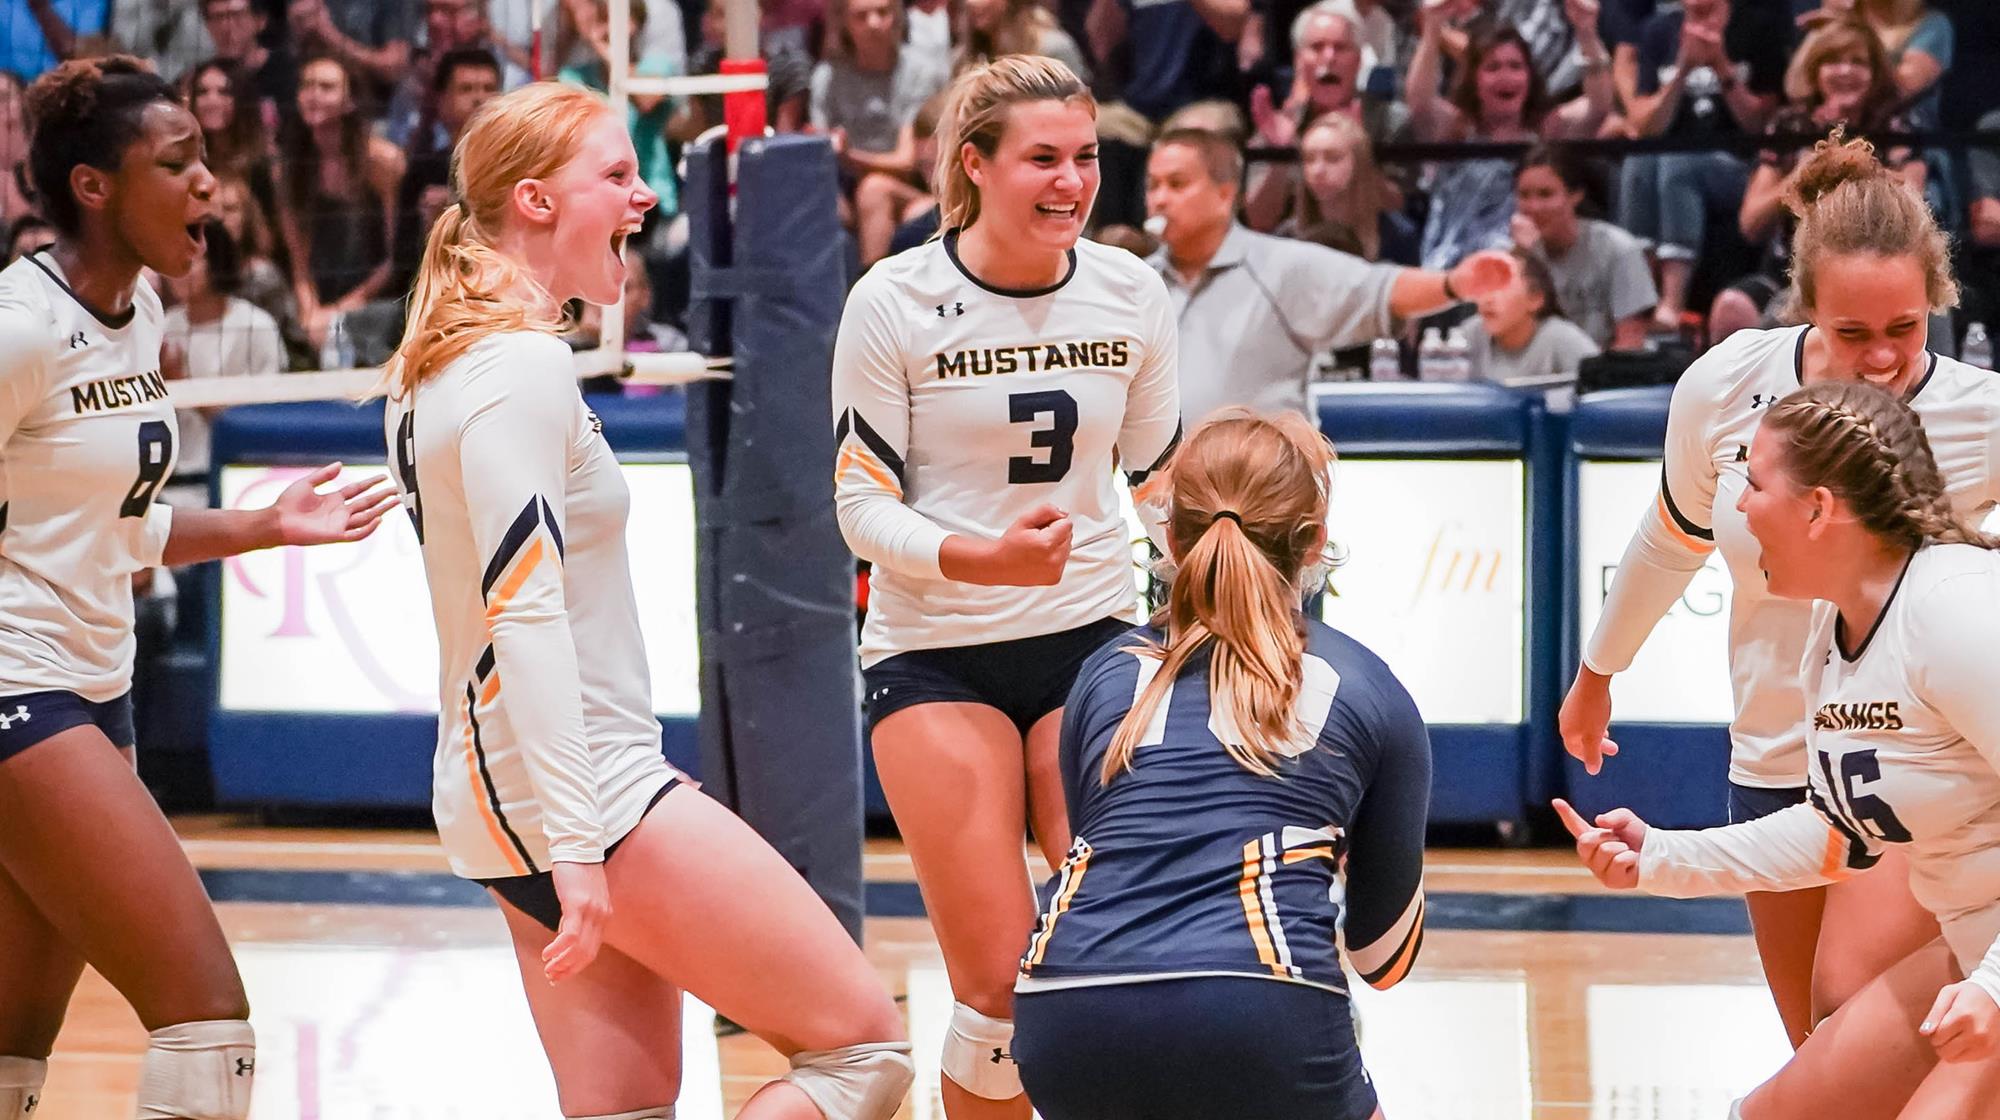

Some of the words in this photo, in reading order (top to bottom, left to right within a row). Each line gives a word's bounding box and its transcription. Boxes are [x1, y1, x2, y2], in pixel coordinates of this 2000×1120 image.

[935, 340, 1129, 380] MUSTANGS
[118, 420, 173, 519] 8
[1007, 389, 1079, 485] 3
[1813, 701, 1904, 731] STANGS
[1818, 748, 1915, 843] 16
